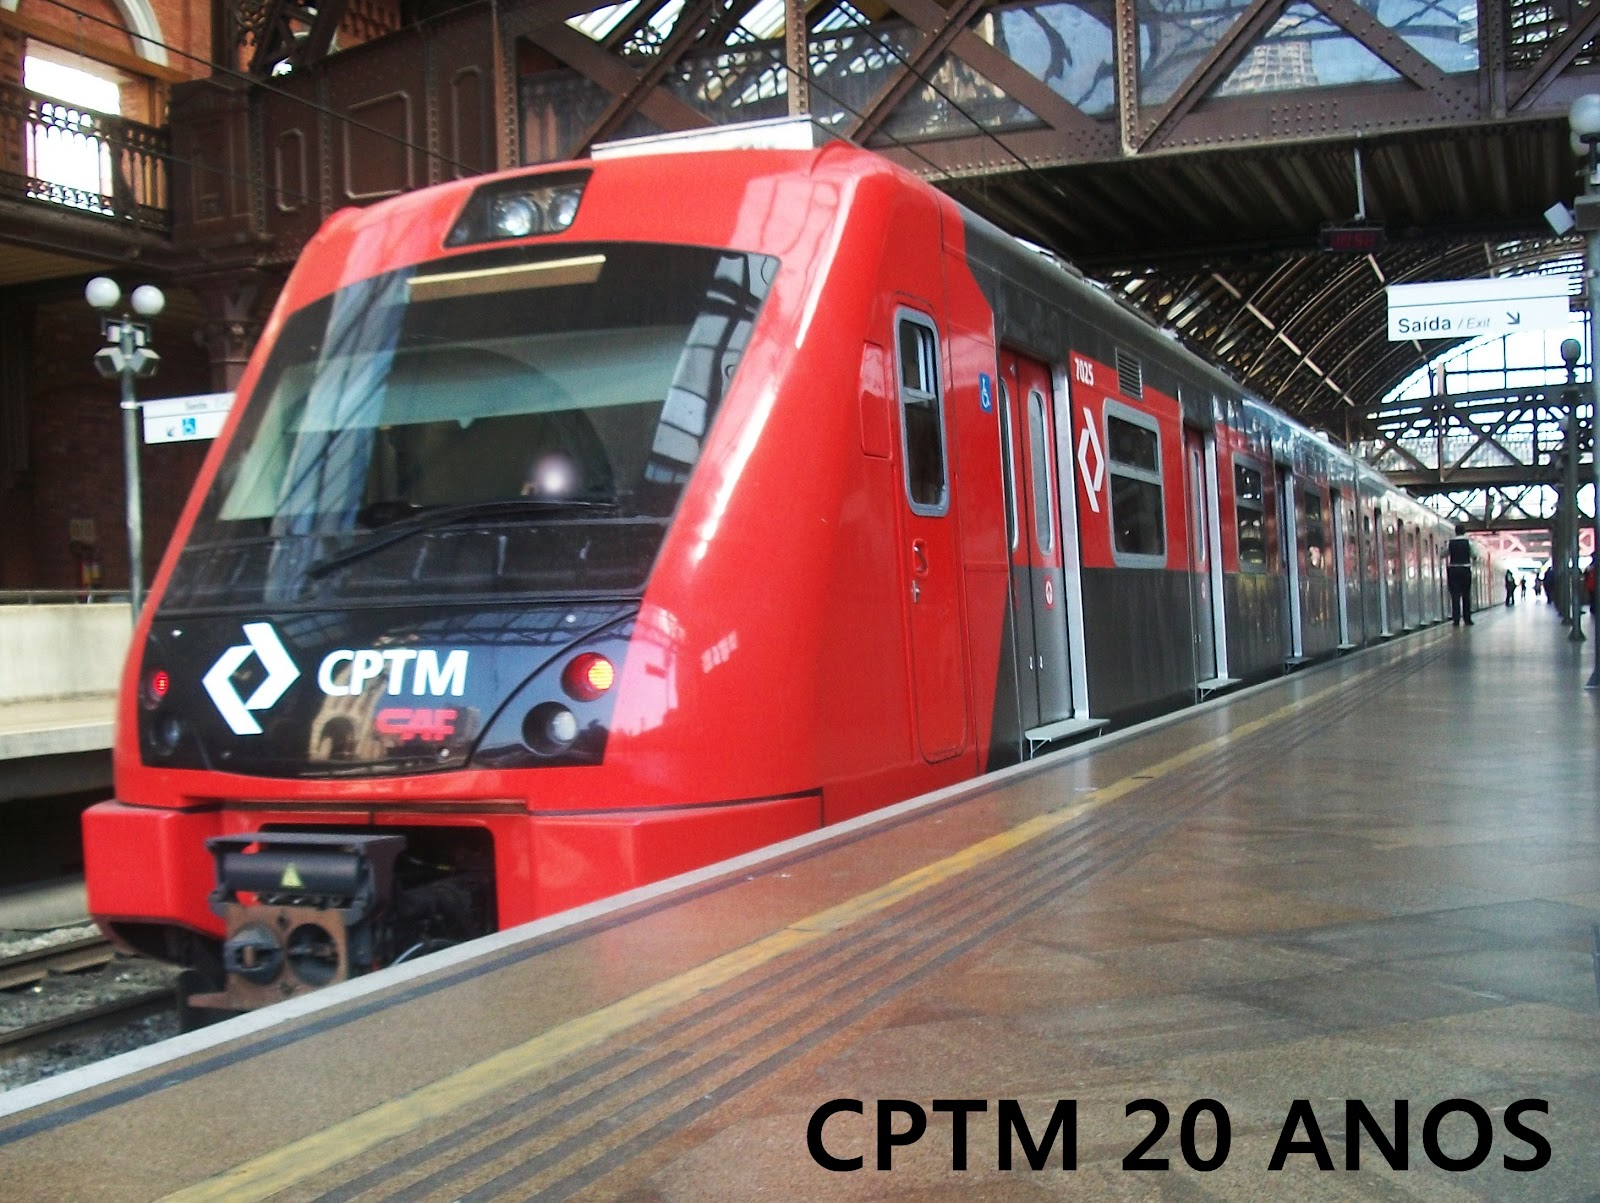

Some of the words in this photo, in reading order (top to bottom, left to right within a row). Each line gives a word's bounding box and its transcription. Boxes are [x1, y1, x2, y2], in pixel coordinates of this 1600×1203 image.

[1398, 316, 1451, 334] Saída
[1074, 357, 1095, 387] 7025
[317, 649, 470, 697] CPTM
